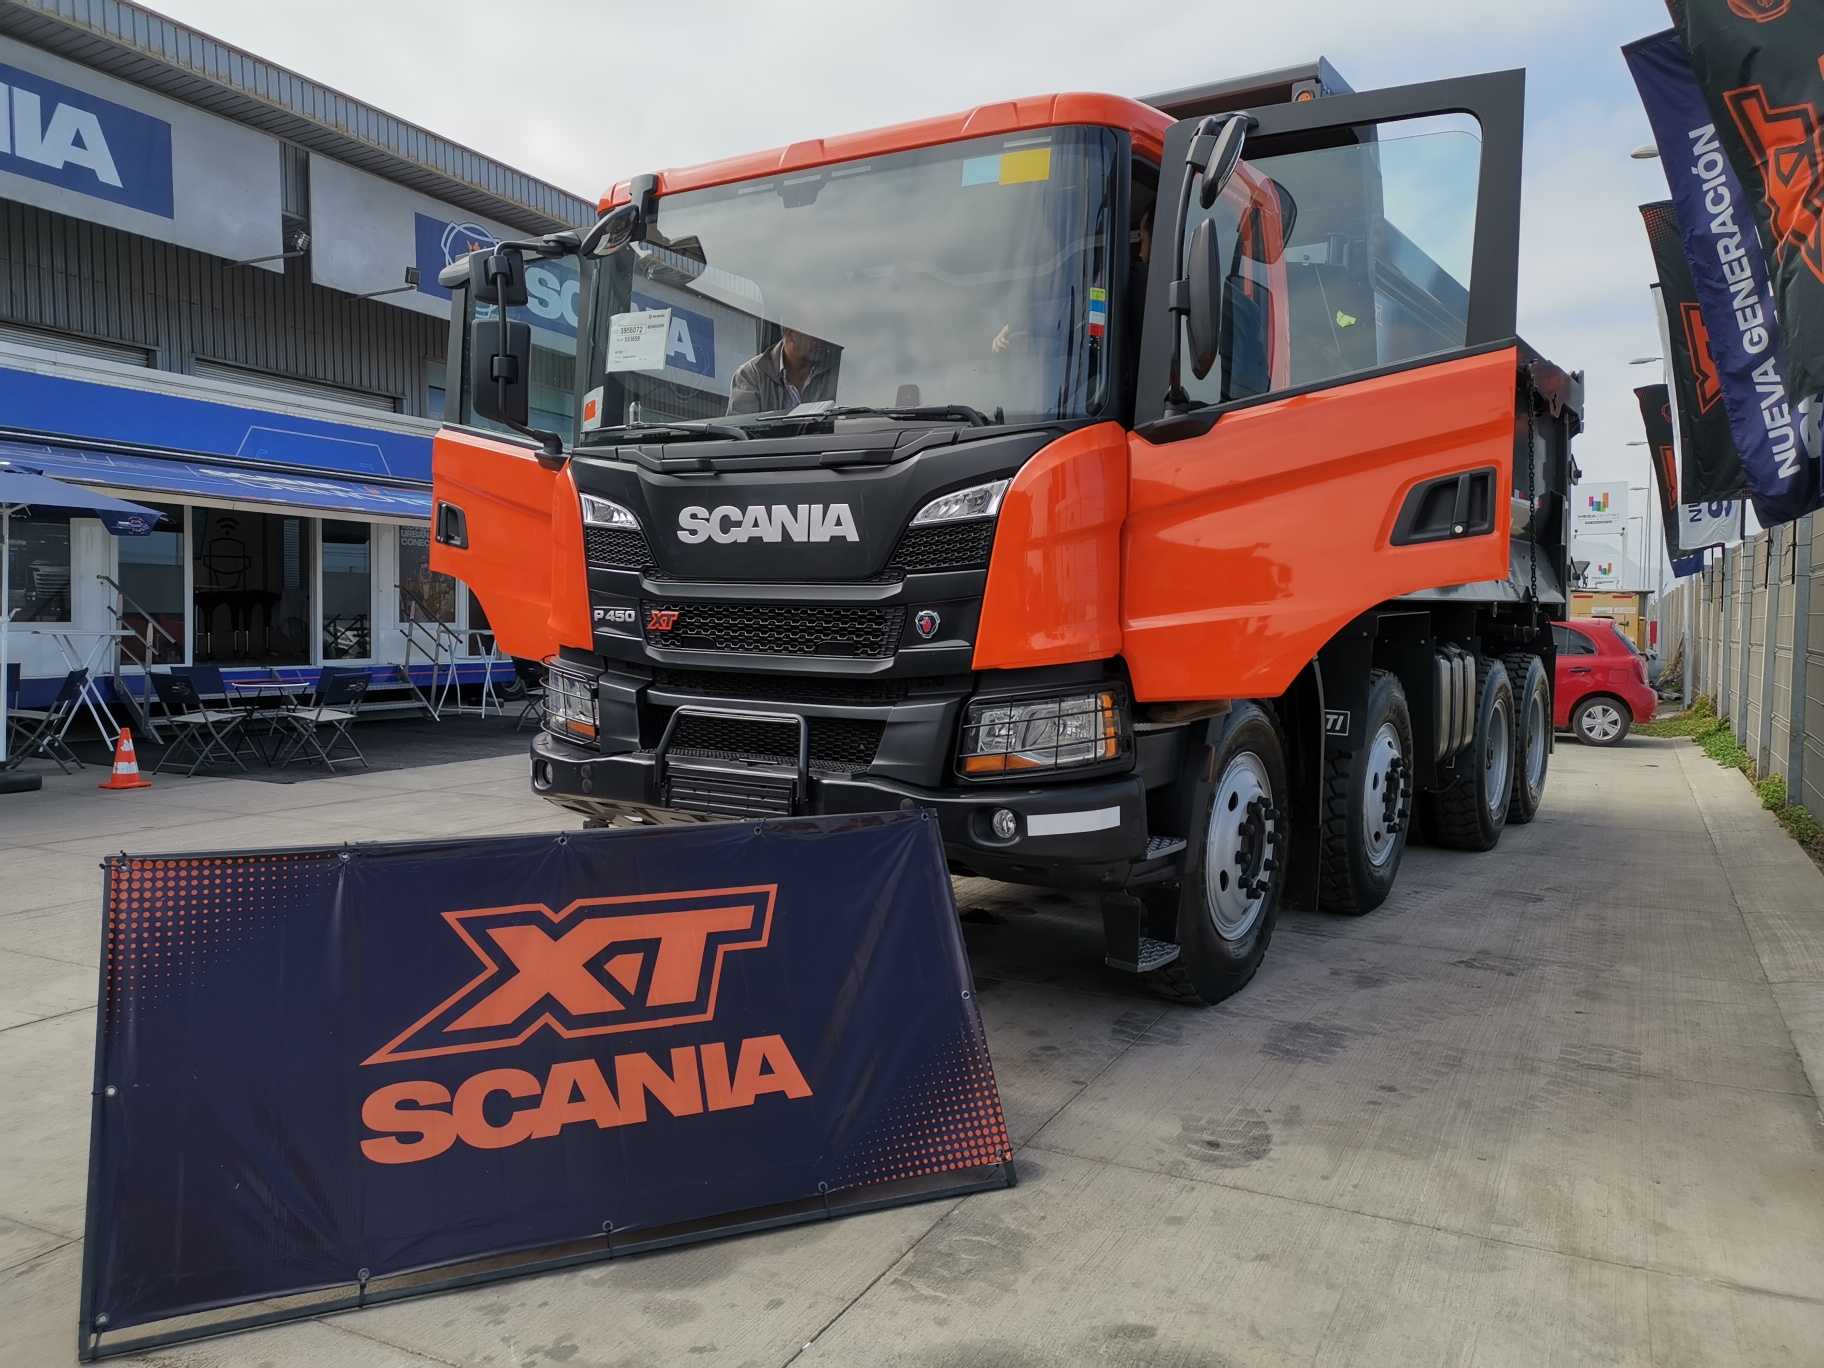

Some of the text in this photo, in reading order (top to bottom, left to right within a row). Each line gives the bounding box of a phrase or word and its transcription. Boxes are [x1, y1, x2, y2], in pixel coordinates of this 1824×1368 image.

[0, 81, 125, 188] IA
[1688, 123, 1770, 354] GENERACIÓN
[1752, 356, 1801, 479] NUEVA
[676, 503, 860, 545] SCANIA
[594, 609, 636, 622] P 450
[647, 610, 680, 631] XT
[359, 1034, 813, 1165] SCANIA
